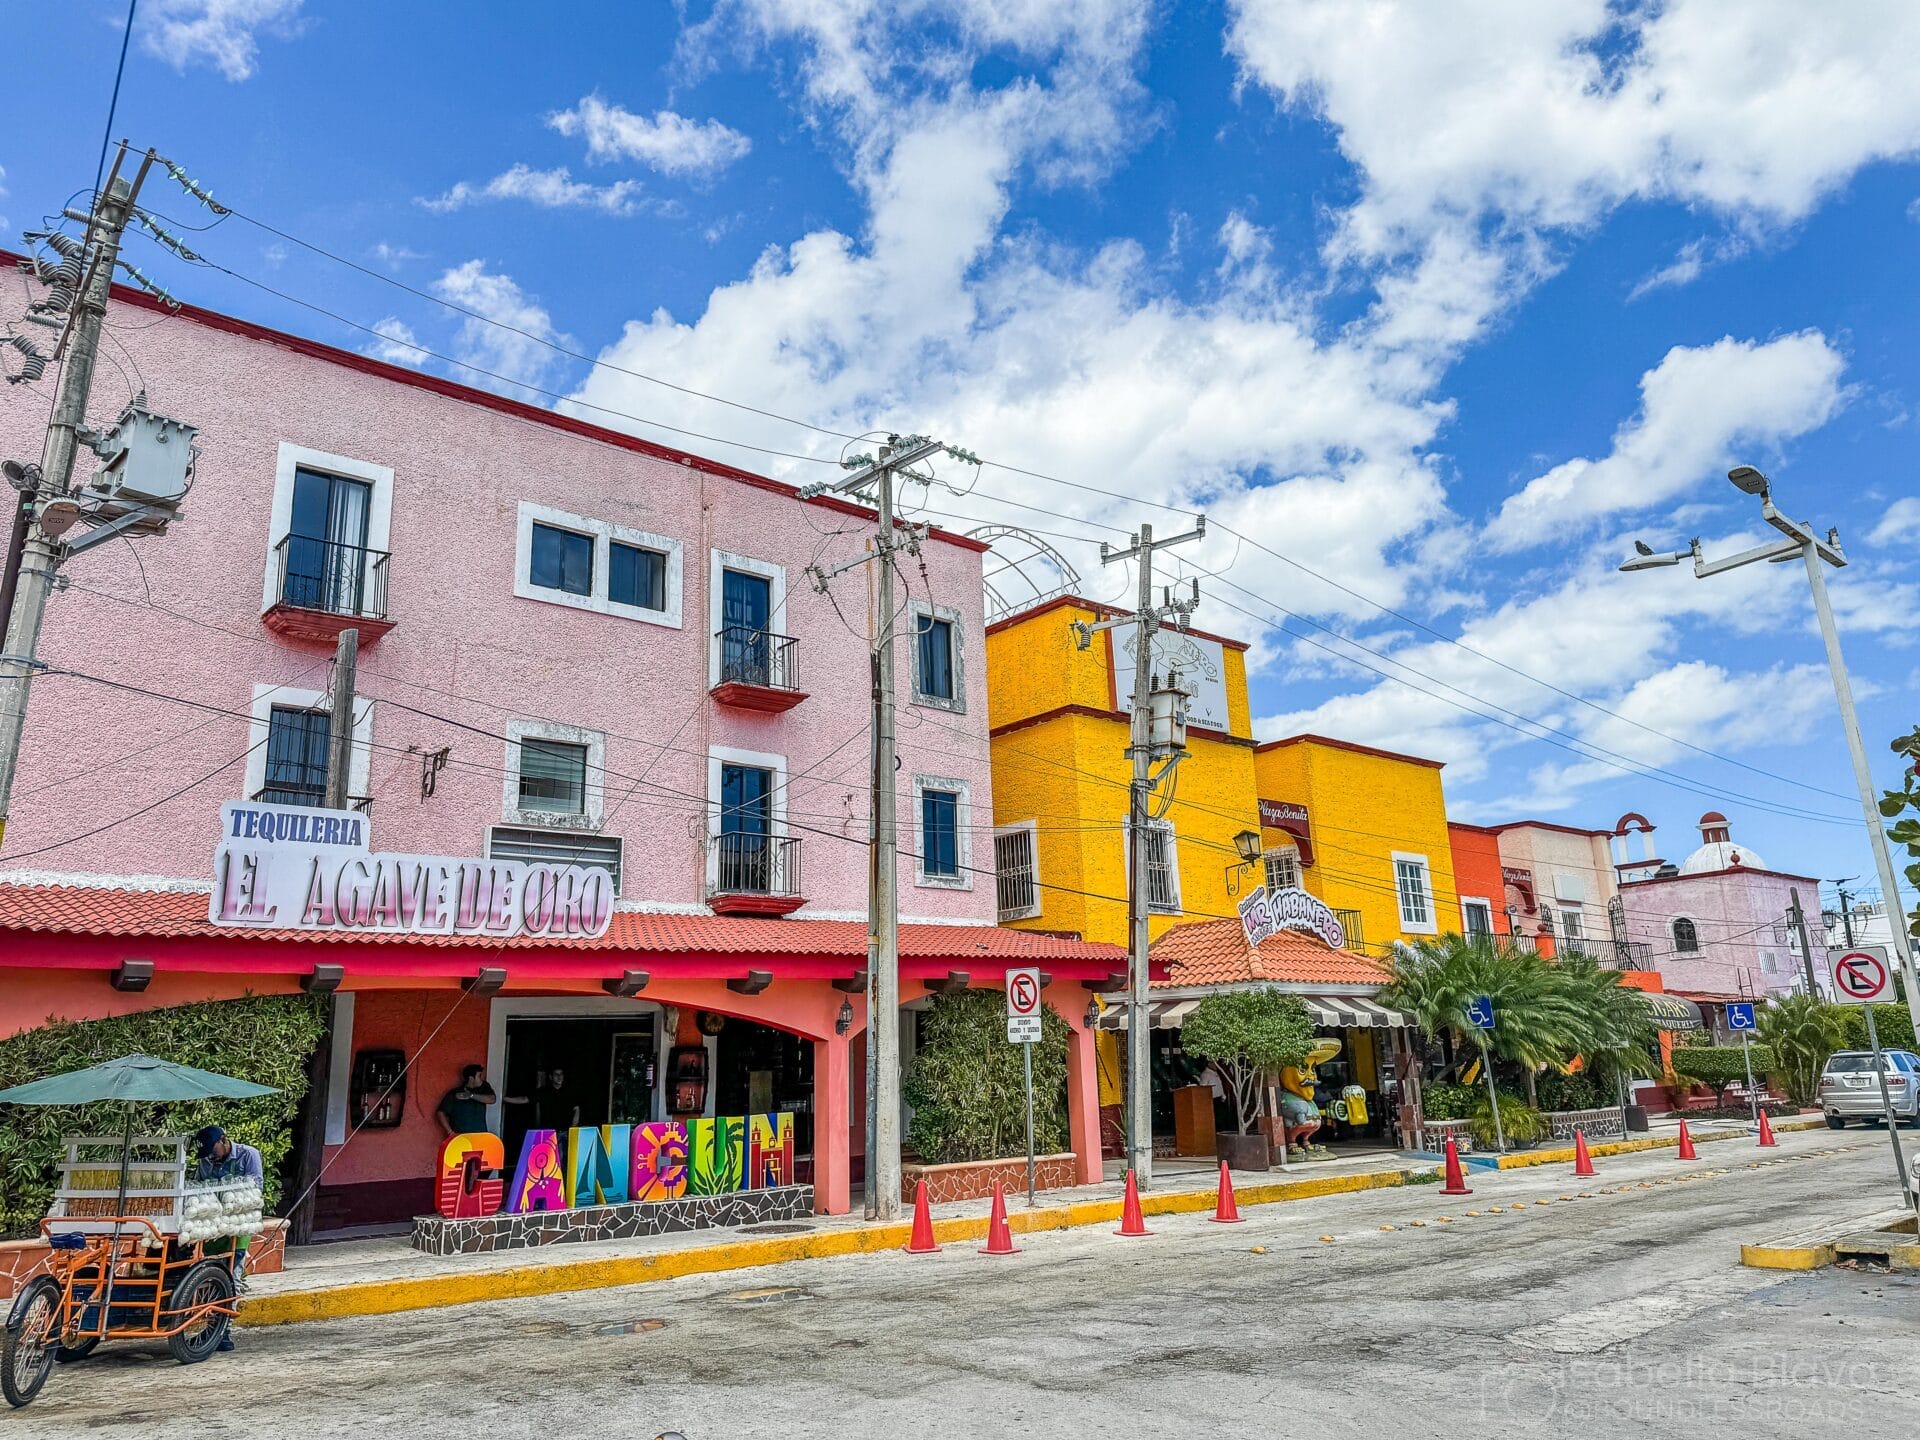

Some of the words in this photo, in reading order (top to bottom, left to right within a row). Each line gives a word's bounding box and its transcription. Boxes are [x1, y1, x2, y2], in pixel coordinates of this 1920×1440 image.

[231, 808, 362, 846] TEQUILERIA
[218, 849, 277, 923] EL
[302, 855, 449, 929] AGAVE
[456, 863, 515, 931] DE
[524, 867, 611, 936] ORO
[1244, 902, 1273, 935] MR
[1271, 891, 1343, 947] HABANERO
[434, 1111, 795, 1219] CANCUN
